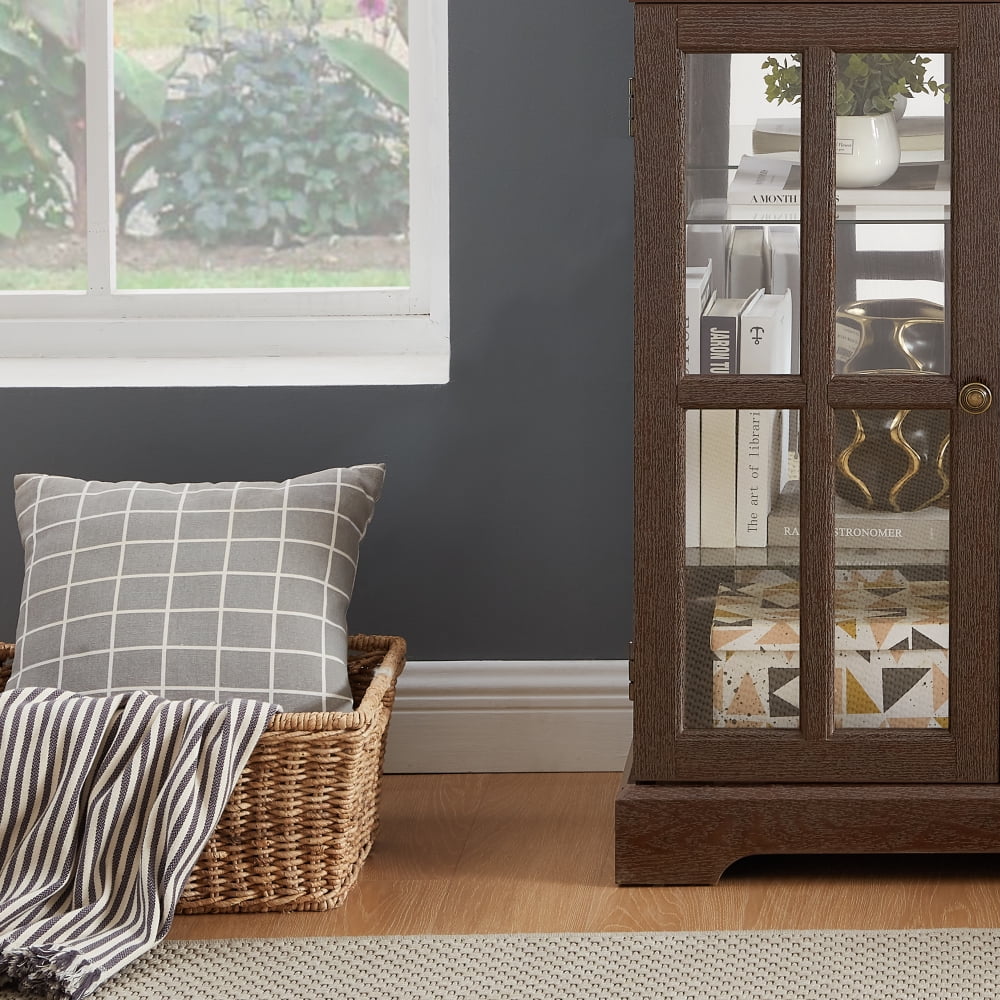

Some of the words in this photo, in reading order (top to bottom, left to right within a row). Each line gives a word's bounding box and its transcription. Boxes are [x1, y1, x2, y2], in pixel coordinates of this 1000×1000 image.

[752, 194, 759, 203] A
[760, 194, 797, 203] MONTH
[710, 327, 730, 360] JARON
[748, 412, 761, 457] librari
[748, 464, 759, 479] of
[750, 486, 759, 506] art
[747, 512, 758, 533] The
[834, 527, 904, 538] STRONOMER
